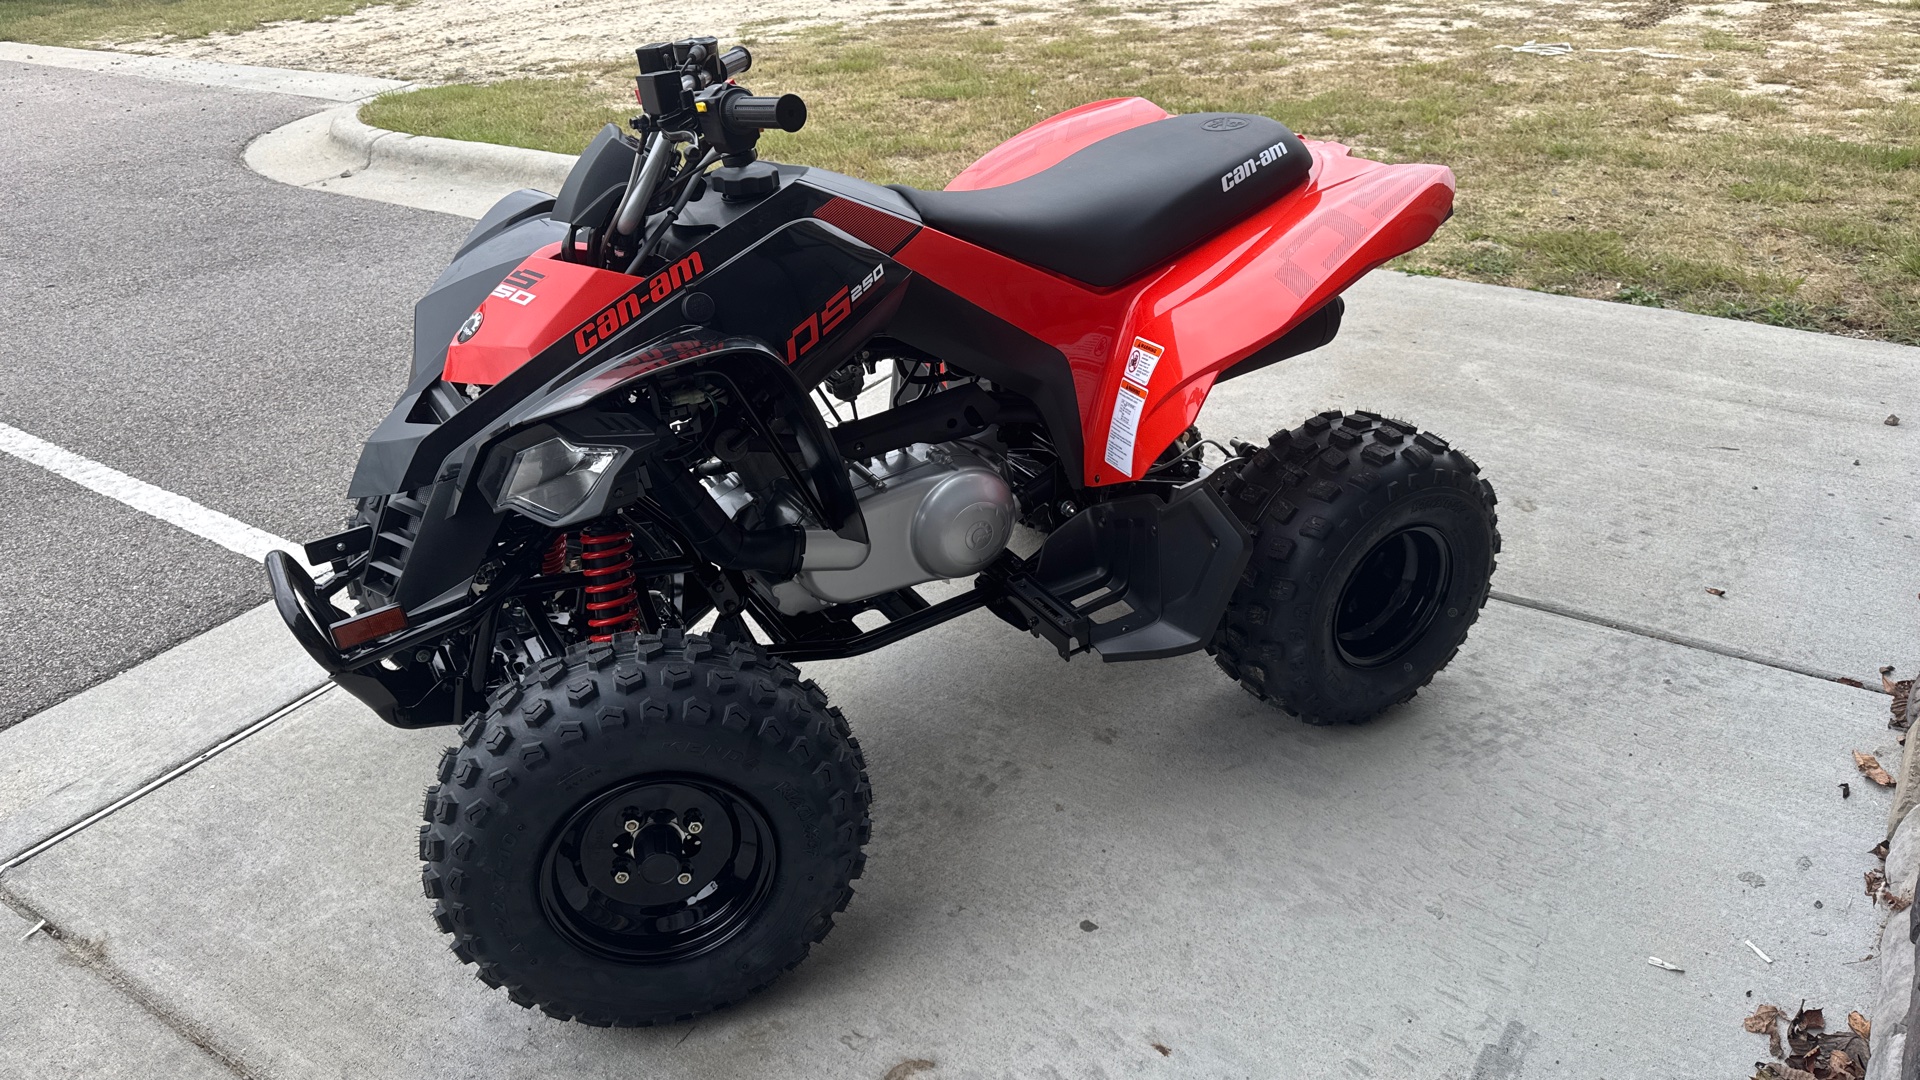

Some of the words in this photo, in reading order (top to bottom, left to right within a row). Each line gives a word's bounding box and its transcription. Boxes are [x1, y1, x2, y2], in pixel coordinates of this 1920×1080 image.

[1221, 141, 1288, 193] can-am
[490, 283, 537, 306] 50
[502, 268, 546, 290] S
[574, 251, 704, 355] can-am
[659, 740, 761, 774] KENDA
